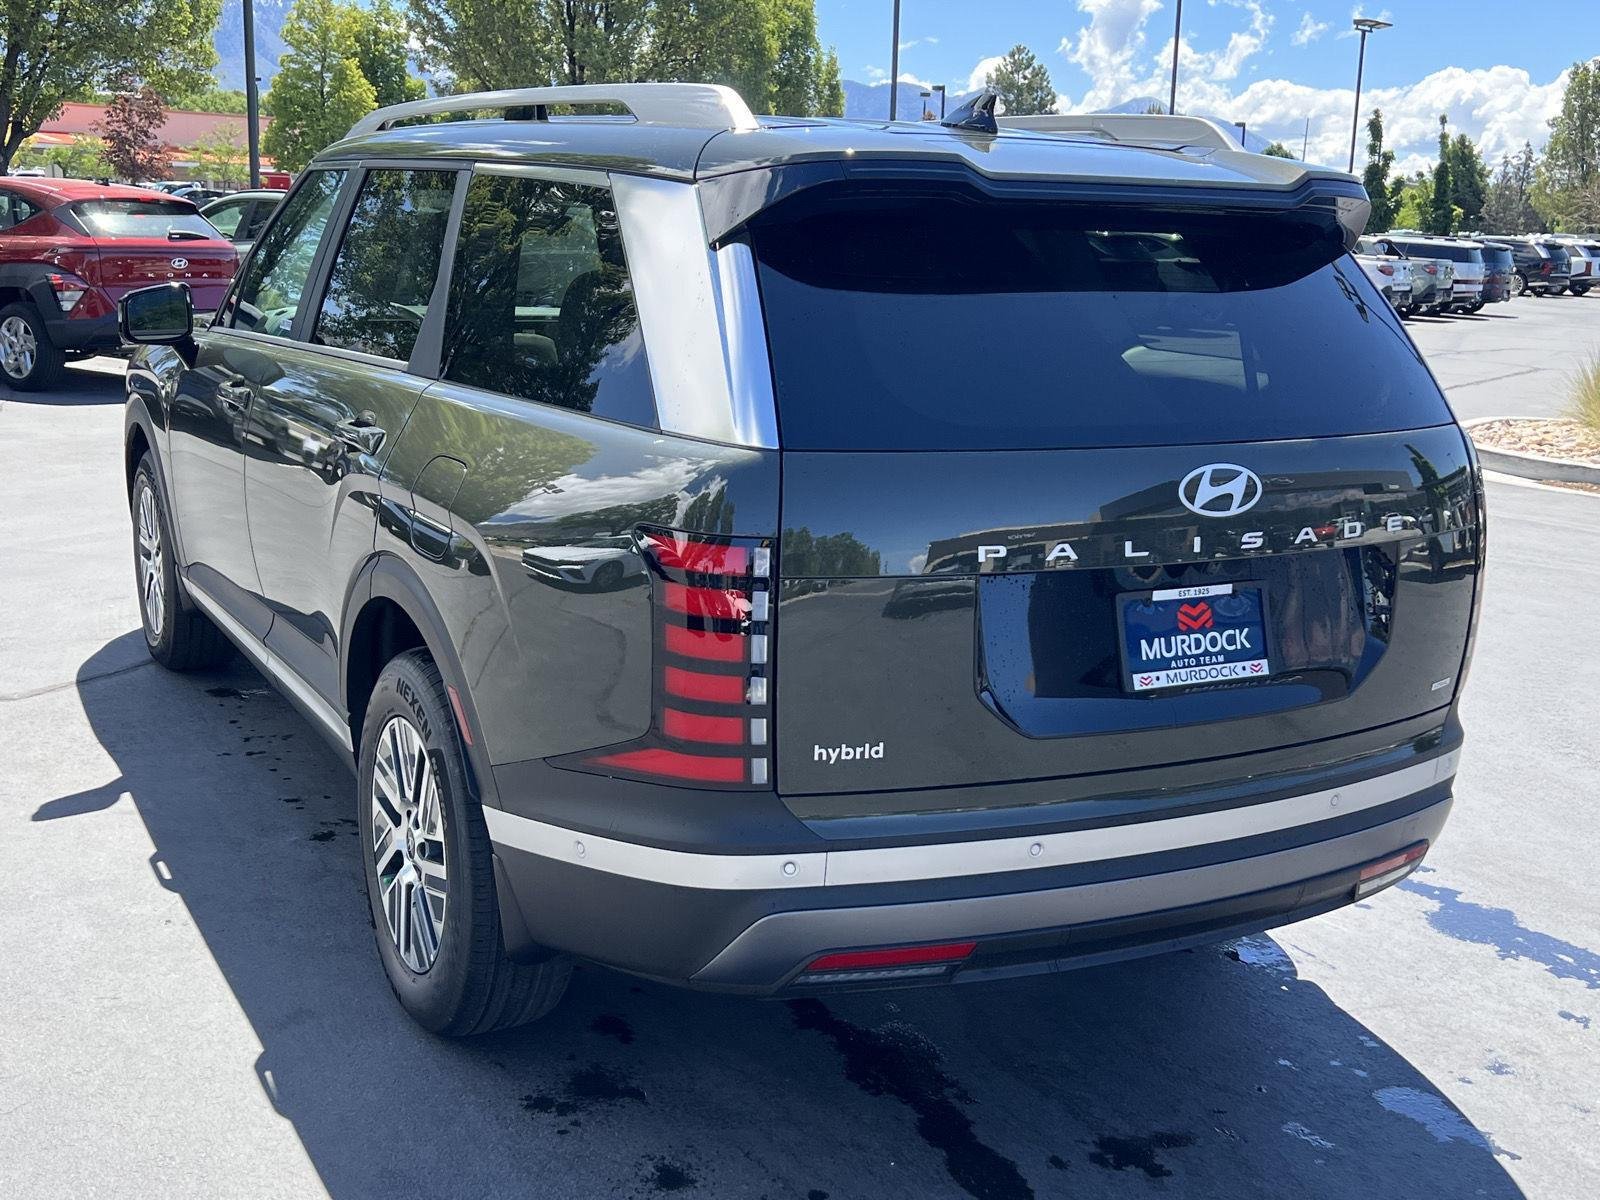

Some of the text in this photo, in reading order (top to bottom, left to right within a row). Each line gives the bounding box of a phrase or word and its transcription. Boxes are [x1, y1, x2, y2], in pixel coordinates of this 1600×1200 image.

[977, 515, 1403, 563] PALISADE
[1178, 589, 1192, 598] EST.
[1140, 628, 1251, 660] MURDOCK
[1170, 654, 1225, 669] AUTO TEAM
[1166, 664, 1240, 685] MURDOCK
[396, 677, 432, 744] NEXEN
[813, 742, 884, 764] hybrid
